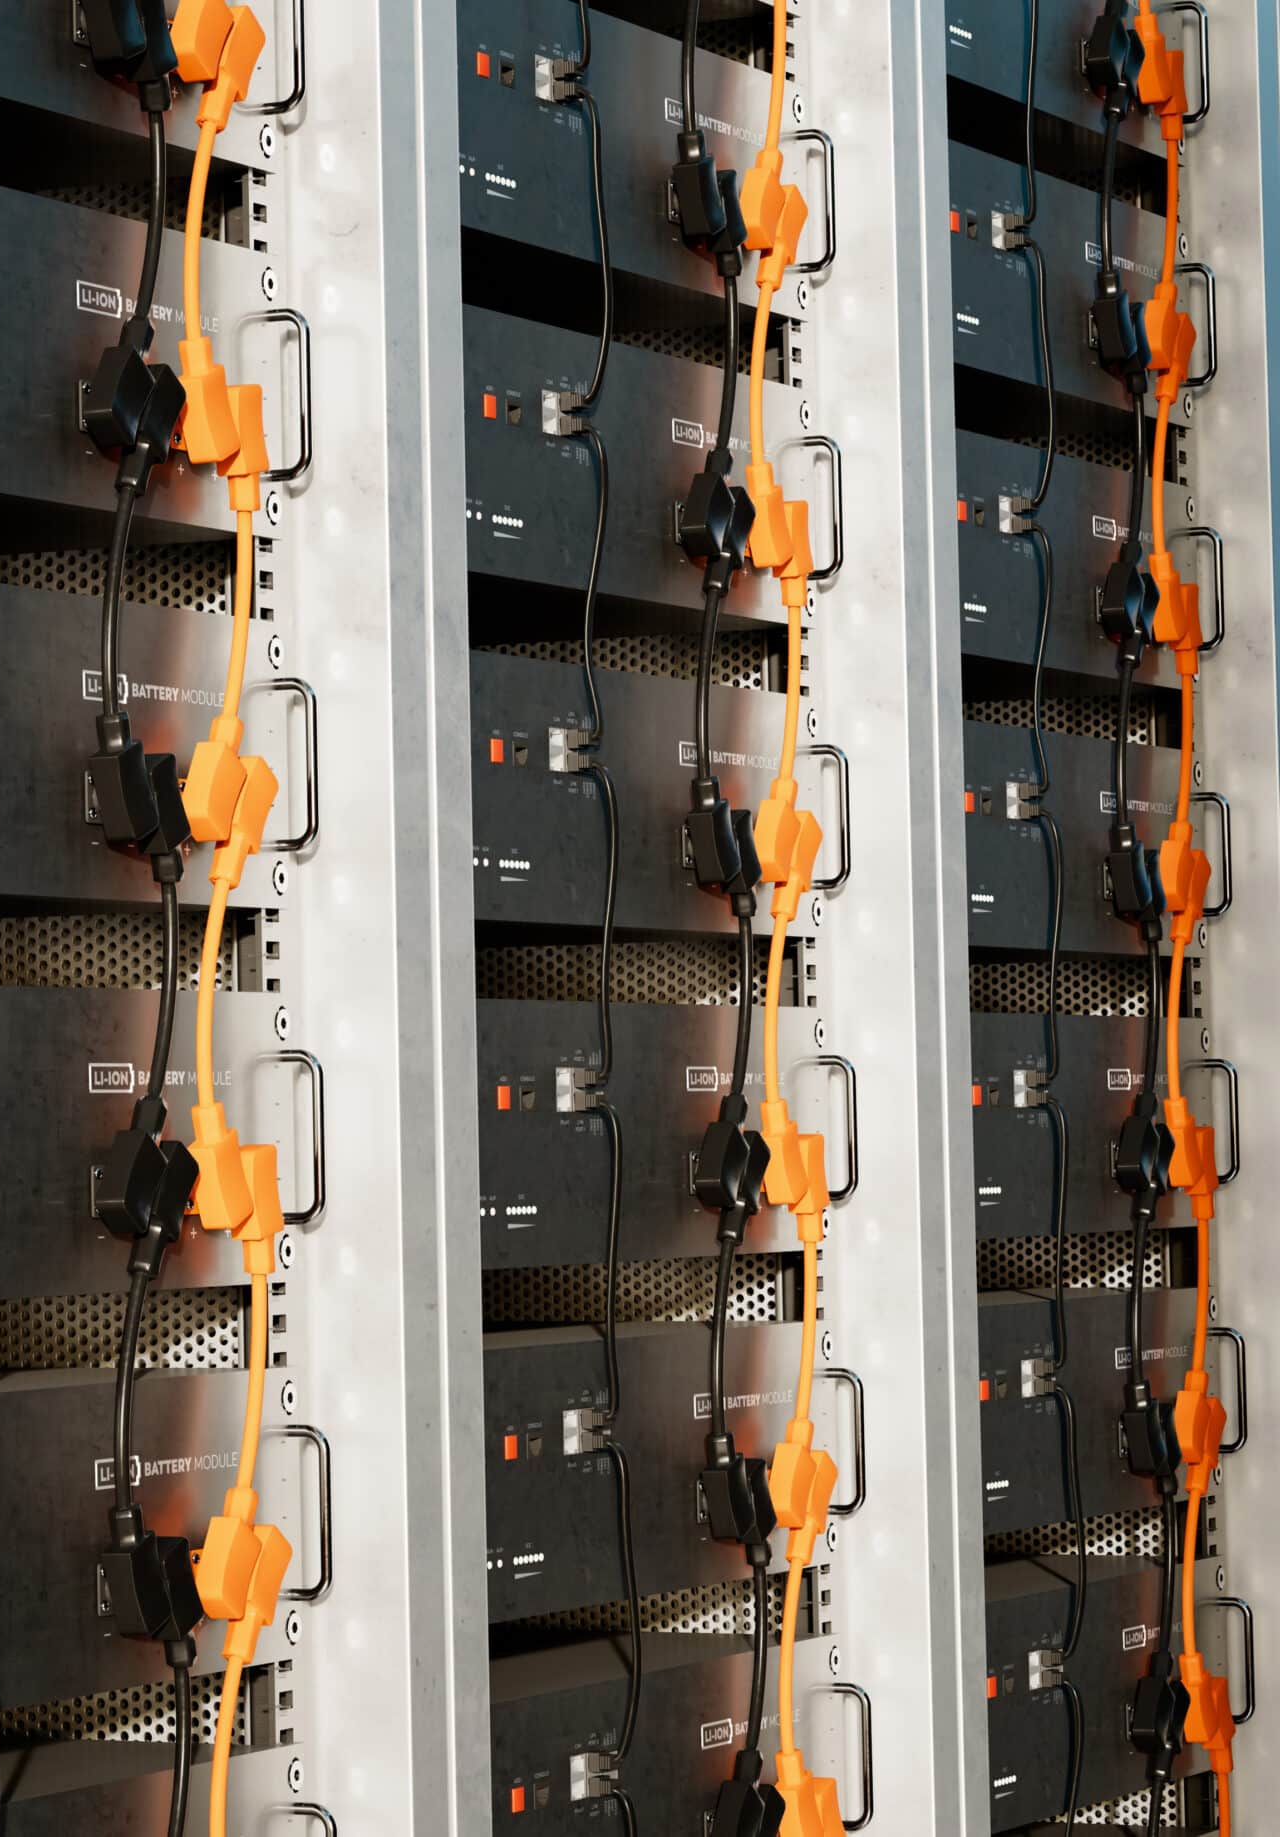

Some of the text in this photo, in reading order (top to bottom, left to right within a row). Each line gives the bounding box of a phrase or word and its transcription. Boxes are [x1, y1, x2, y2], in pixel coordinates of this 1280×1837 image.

[698, 114, 733, 136] BATTERY
[81, 287, 117, 311] LI-ION
[675, 424, 701, 441] LI-ION
[131, 683, 180, 702] BATTERY
[713, 751, 746, 766] BATTERY
[94, 1070, 129, 1087] LI-ION
[690, 1072, 715, 1085] LI-ION
[727, 1393, 761, 1409] BATTERY
[144, 1456, 192, 1477] BATTERY
[194, 1451, 238, 1470] MODULE
[704, 1727, 729, 1742] LI-ION
